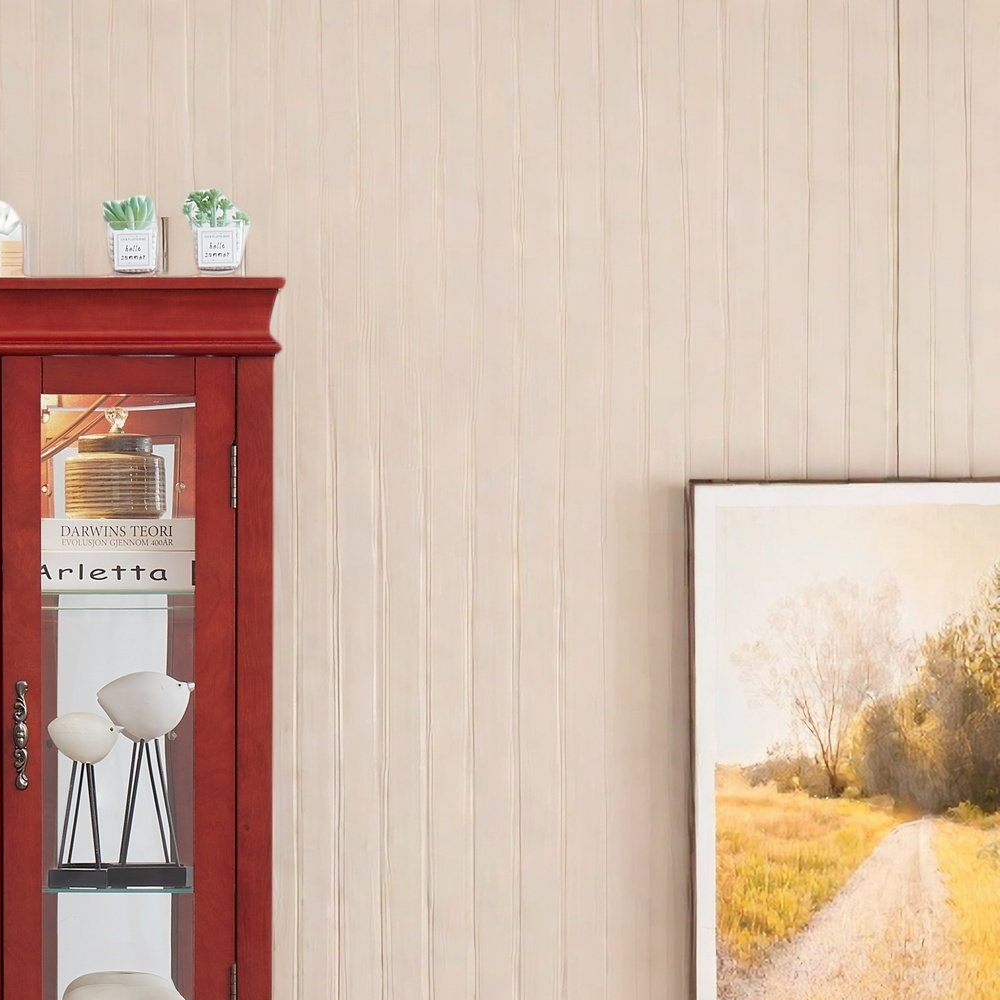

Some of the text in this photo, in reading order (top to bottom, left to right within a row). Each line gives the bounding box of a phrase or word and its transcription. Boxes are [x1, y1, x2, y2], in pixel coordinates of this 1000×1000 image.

[61, 525, 174, 537] DARWINS TEORI
[61, 538, 108, 548] EVOLUSJON
[109, 538, 149, 548] GJENNOM
[41, 563, 168, 581] Arletta
